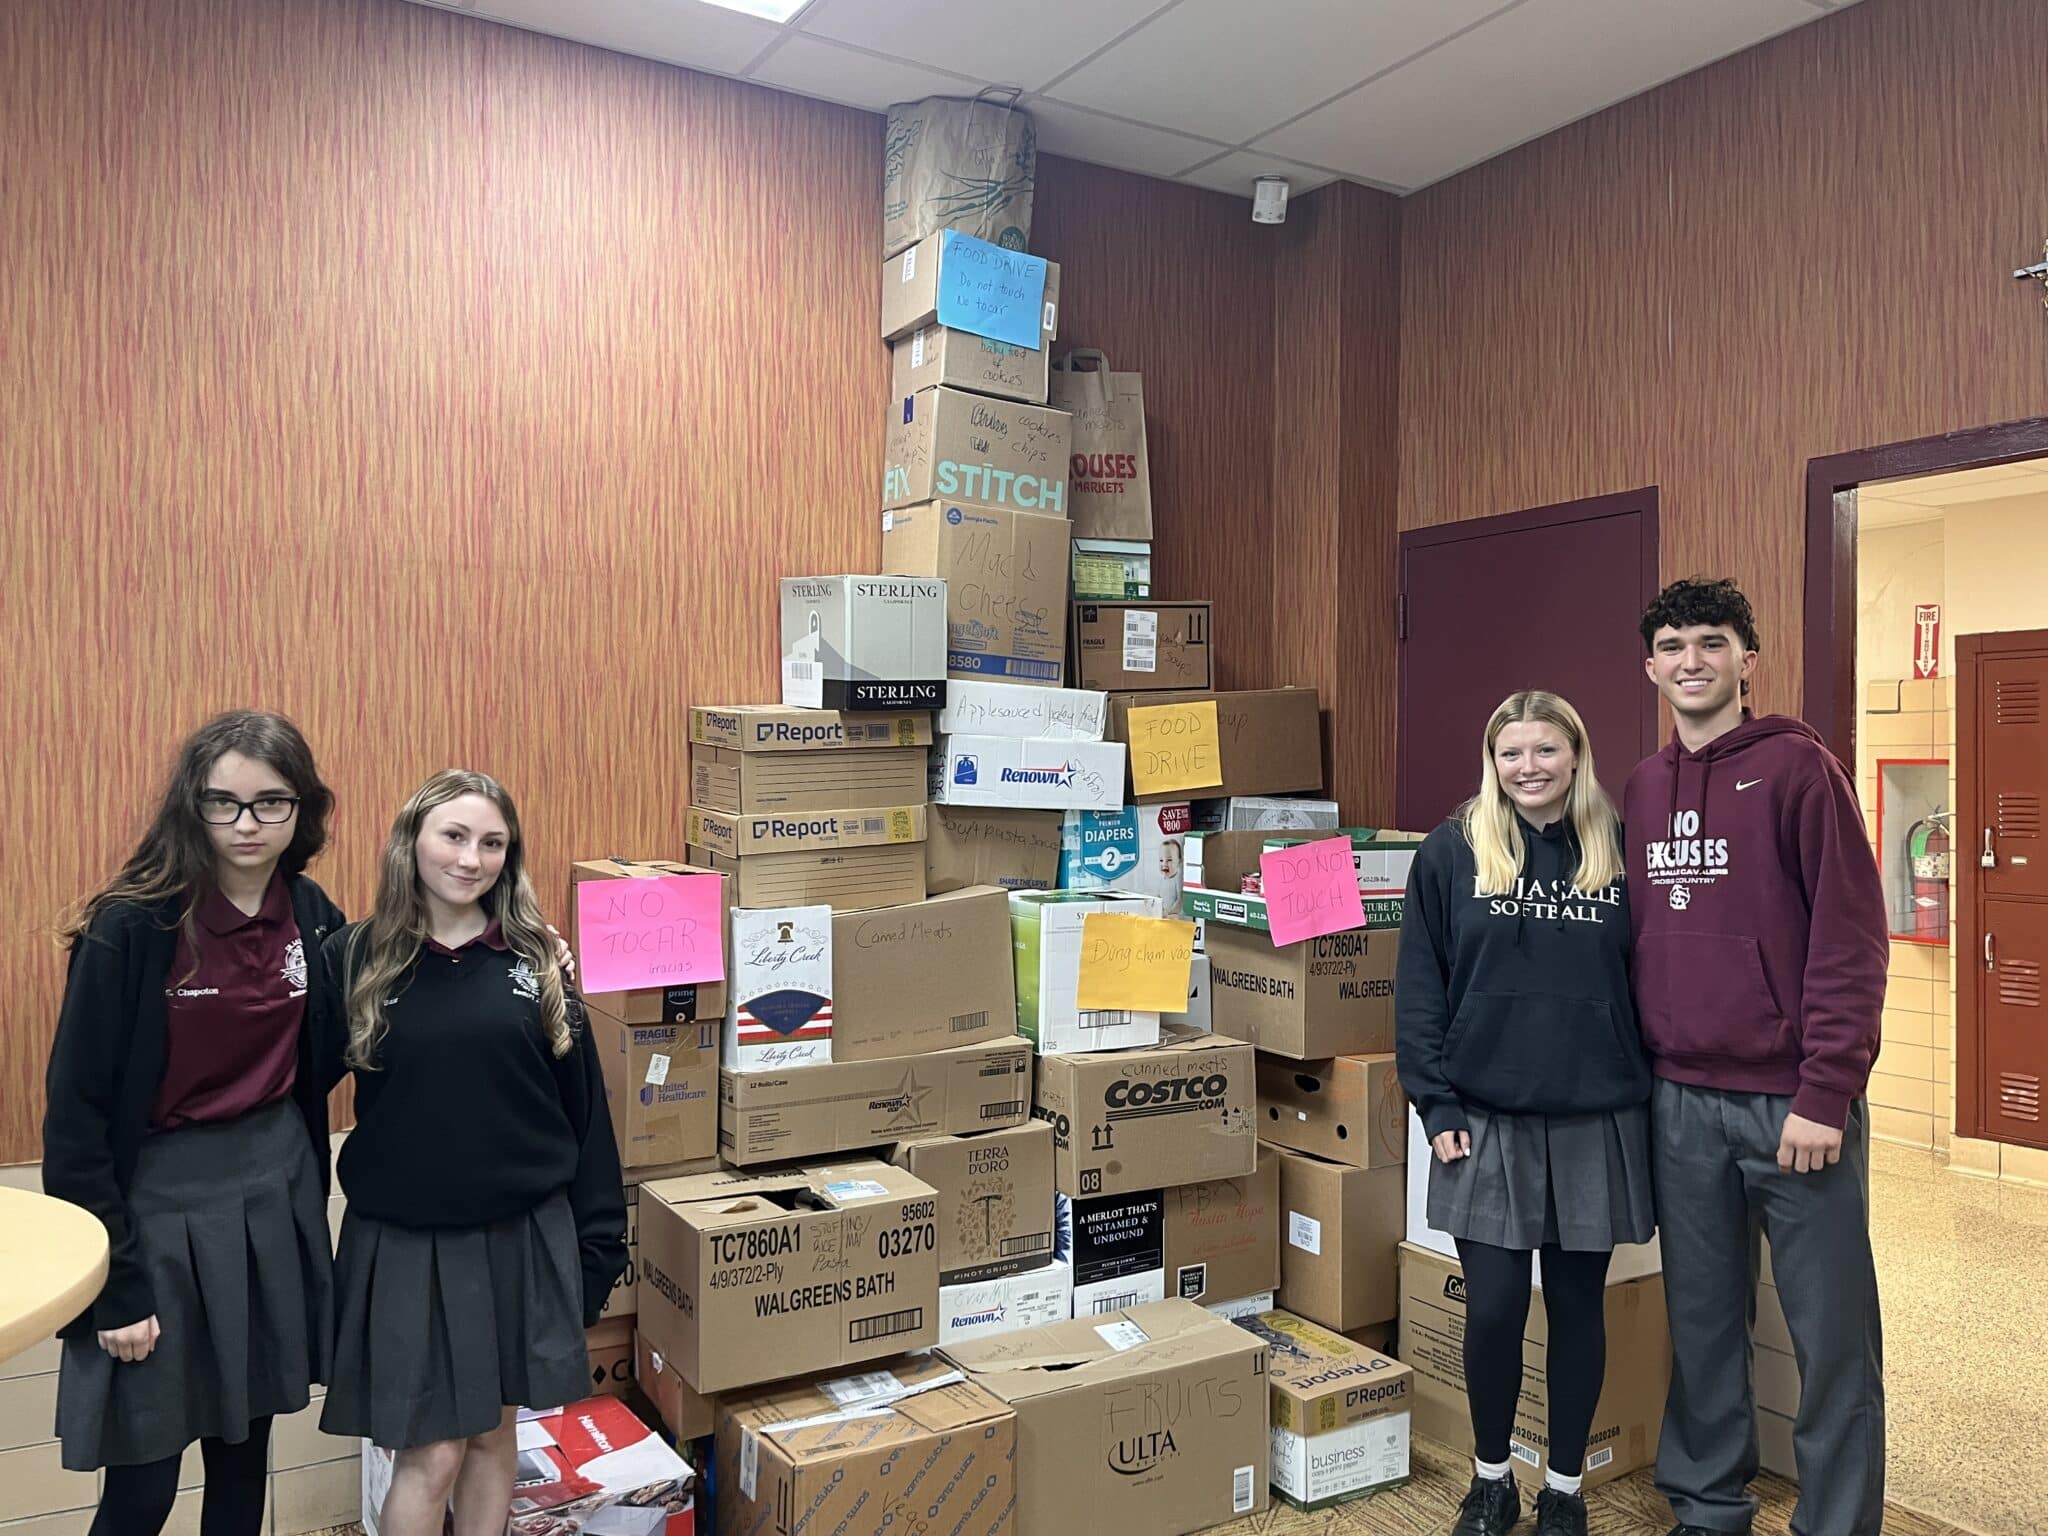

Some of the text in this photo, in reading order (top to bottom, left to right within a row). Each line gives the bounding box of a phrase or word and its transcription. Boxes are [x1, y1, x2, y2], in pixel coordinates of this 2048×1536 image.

[952, 241, 1039, 278] FOOD DRIVE
[977, 280, 992, 292] not
[999, 282, 1025, 300] touch
[976, 298, 1009, 315] tocar
[982, 369, 1022, 386] cookies
[1071, 453, 1137, 479] OUSES
[1074, 481, 1124, 494] MARKETS
[957, 532, 1016, 578] Mac
[792, 584, 832, 598] STERLING
[857, 584, 937, 599] STERLING
[1919, 611, 1937, 621] FIRE
[857, 686, 936, 700] STERLING
[713, 714, 737, 732] Report
[776, 723, 842, 744] Report
[1146, 712, 1201, 738] FOOD
[1146, 744, 1210, 775] DRIVE
[1001, 767, 1060, 784] Renown
[1162, 808, 1182, 820] SAVE
[709, 818, 732, 839] Report
[772, 818, 838, 840] Report
[1085, 828, 1134, 842] DIAPERS
[1163, 820, 1181, 831] $800
[1106, 851, 1115, 866] 2
[1279, 850, 1351, 884] DO NOT
[608, 891, 664, 921] NO
[1281, 886, 1344, 922] TOUCH
[1489, 899, 1604, 923] SOFTBALL
[602, 918, 697, 958] TOCAR
[1312, 935, 1369, 959] TC7860A1
[744, 945, 825, 971] Liberty Creek
[668, 989, 694, 998] prime
[1213, 968, 1295, 1000] WALGREENS BATH
[1339, 979, 1395, 1000] WALGREEN
[634, 1028, 676, 1040] FRAGILE
[756, 1047, 787, 1066] Liberty
[658, 1090, 707, 1103] Healthcare
[659, 1081, 688, 1093] United
[1105, 1075, 1228, 1109] COSTCO
[868, 1099, 903, 1111] Renown
[968, 1147, 1009, 1162] TERRA
[969, 1159, 1009, 1175] D'ORO
[1081, 1171, 1100, 1191] 08
[902, 1200, 935, 1222] 95602
[1079, 1202, 1158, 1225] A MERLOT THAT'S
[1088, 1216, 1149, 1234] UNTAMED &
[711, 1224, 801, 1265] TC7860A1
[878, 1225, 935, 1259] 03270
[1093, 1228, 1144, 1245] UNBOUND
[953, 1263, 1019, 1280] PINOT GRIGIO
[643, 1257, 694, 1320] WALGREENS BATH
[755, 1271, 895, 1318] WALGREENS BATH
[951, 1312, 995, 1328] Renown
[1291, 1363, 1372, 1390] Report
[1359, 1380, 1406, 1405] Report
[1104, 1377, 1242, 1433] FRUITS
[577, 1414, 614, 1453] Hamilton
[1119, 1430, 1177, 1465] ULTA
[1312, 1445, 1365, 1470] business
[904, 1445, 943, 1498] sam's club
[814, 1482, 835, 1508] club
